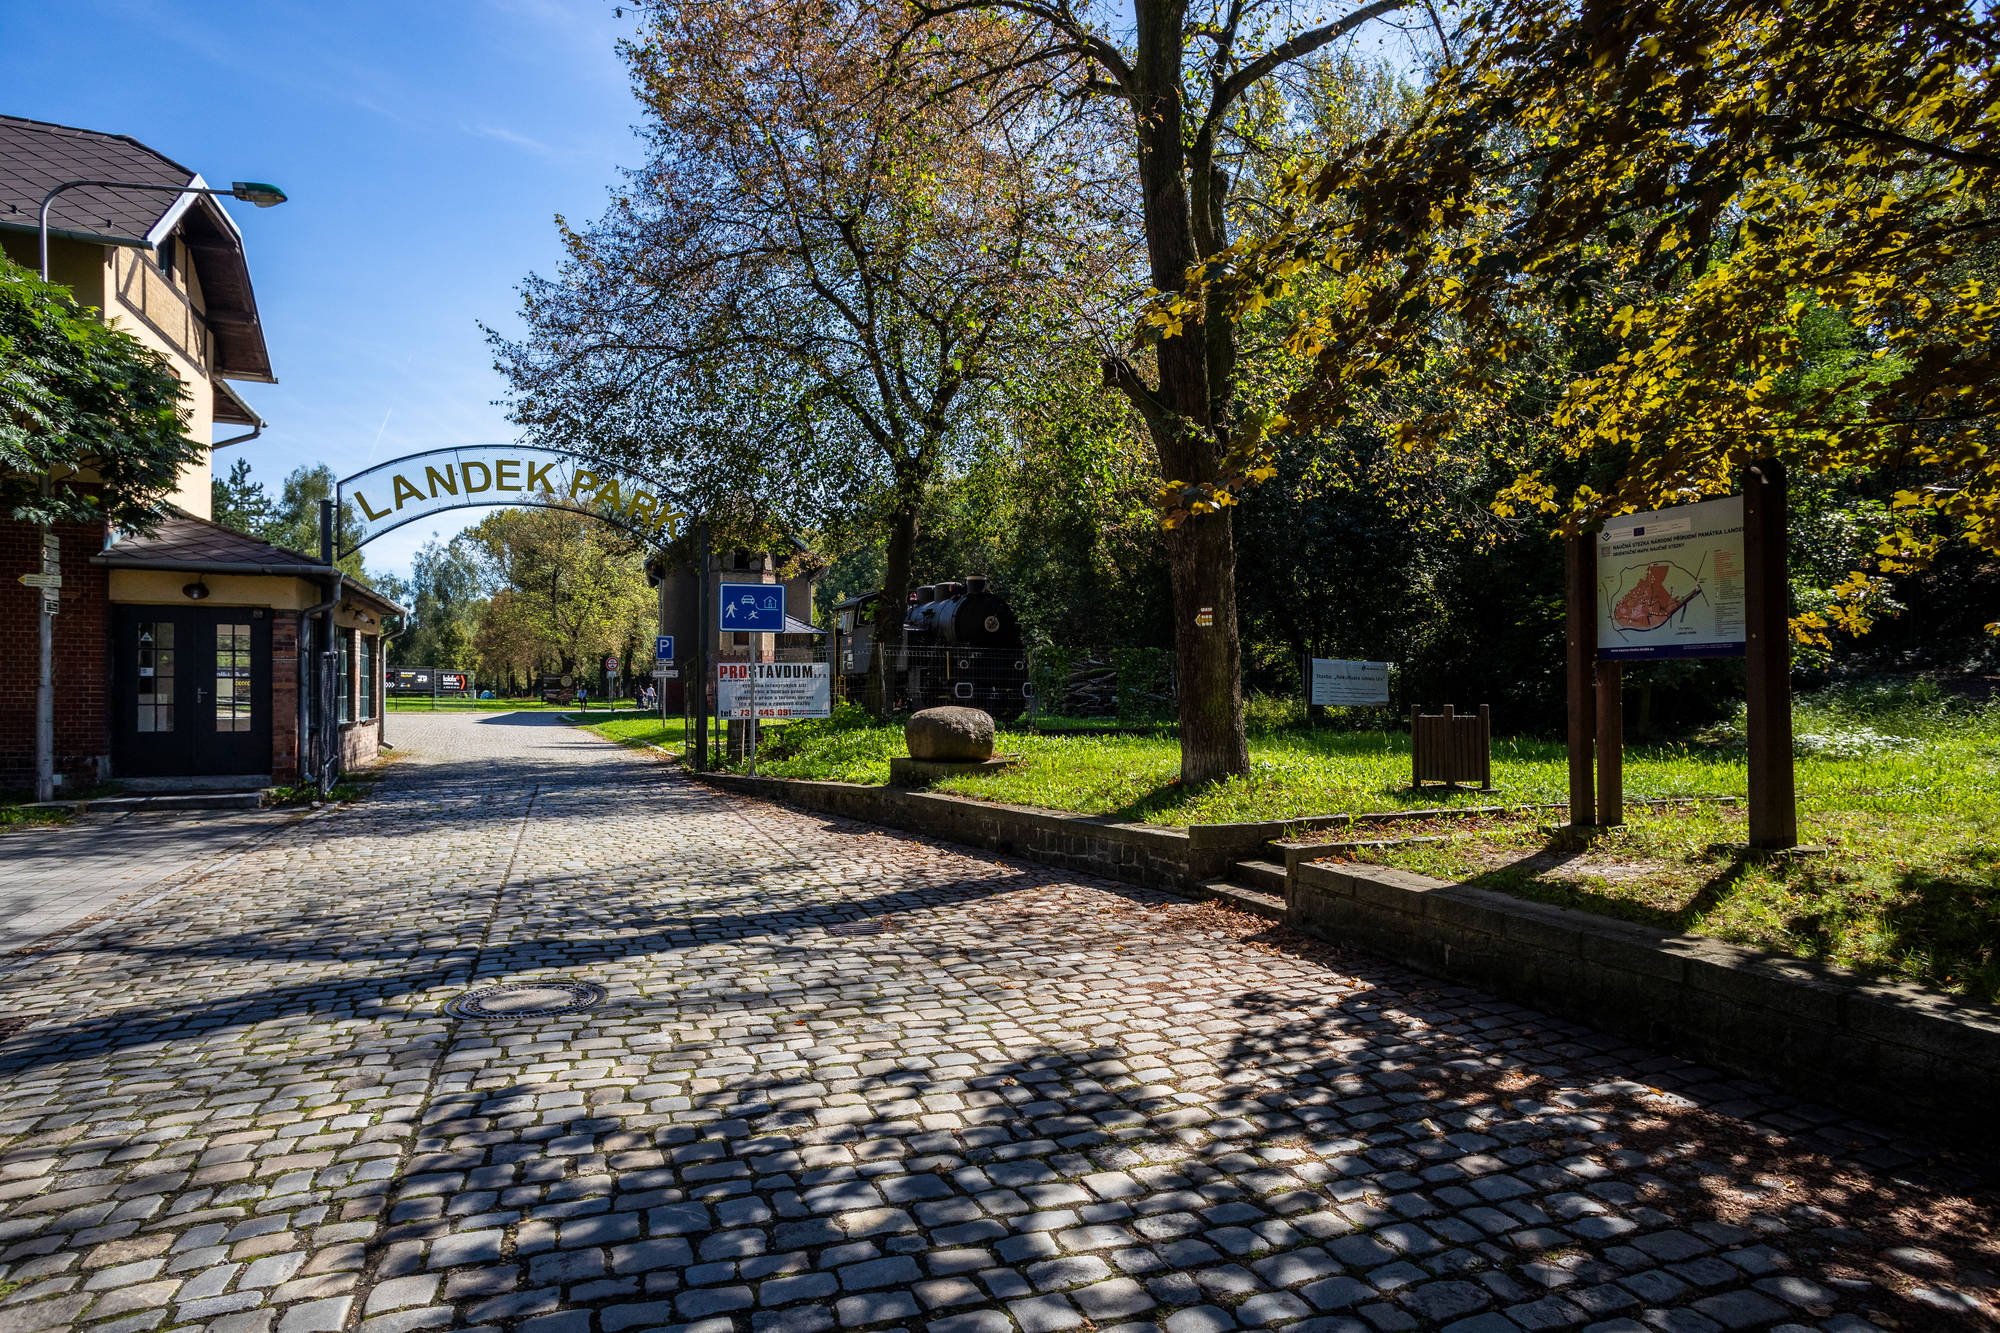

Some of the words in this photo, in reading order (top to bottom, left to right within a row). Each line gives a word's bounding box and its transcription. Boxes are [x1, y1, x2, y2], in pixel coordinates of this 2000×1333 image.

[354, 459, 555, 522] LANDEK
[569, 468, 687, 540] PARK
[660, 639, 670, 653] P
[740, 709, 755, 717] 73
[758, 709, 775, 717] 445
